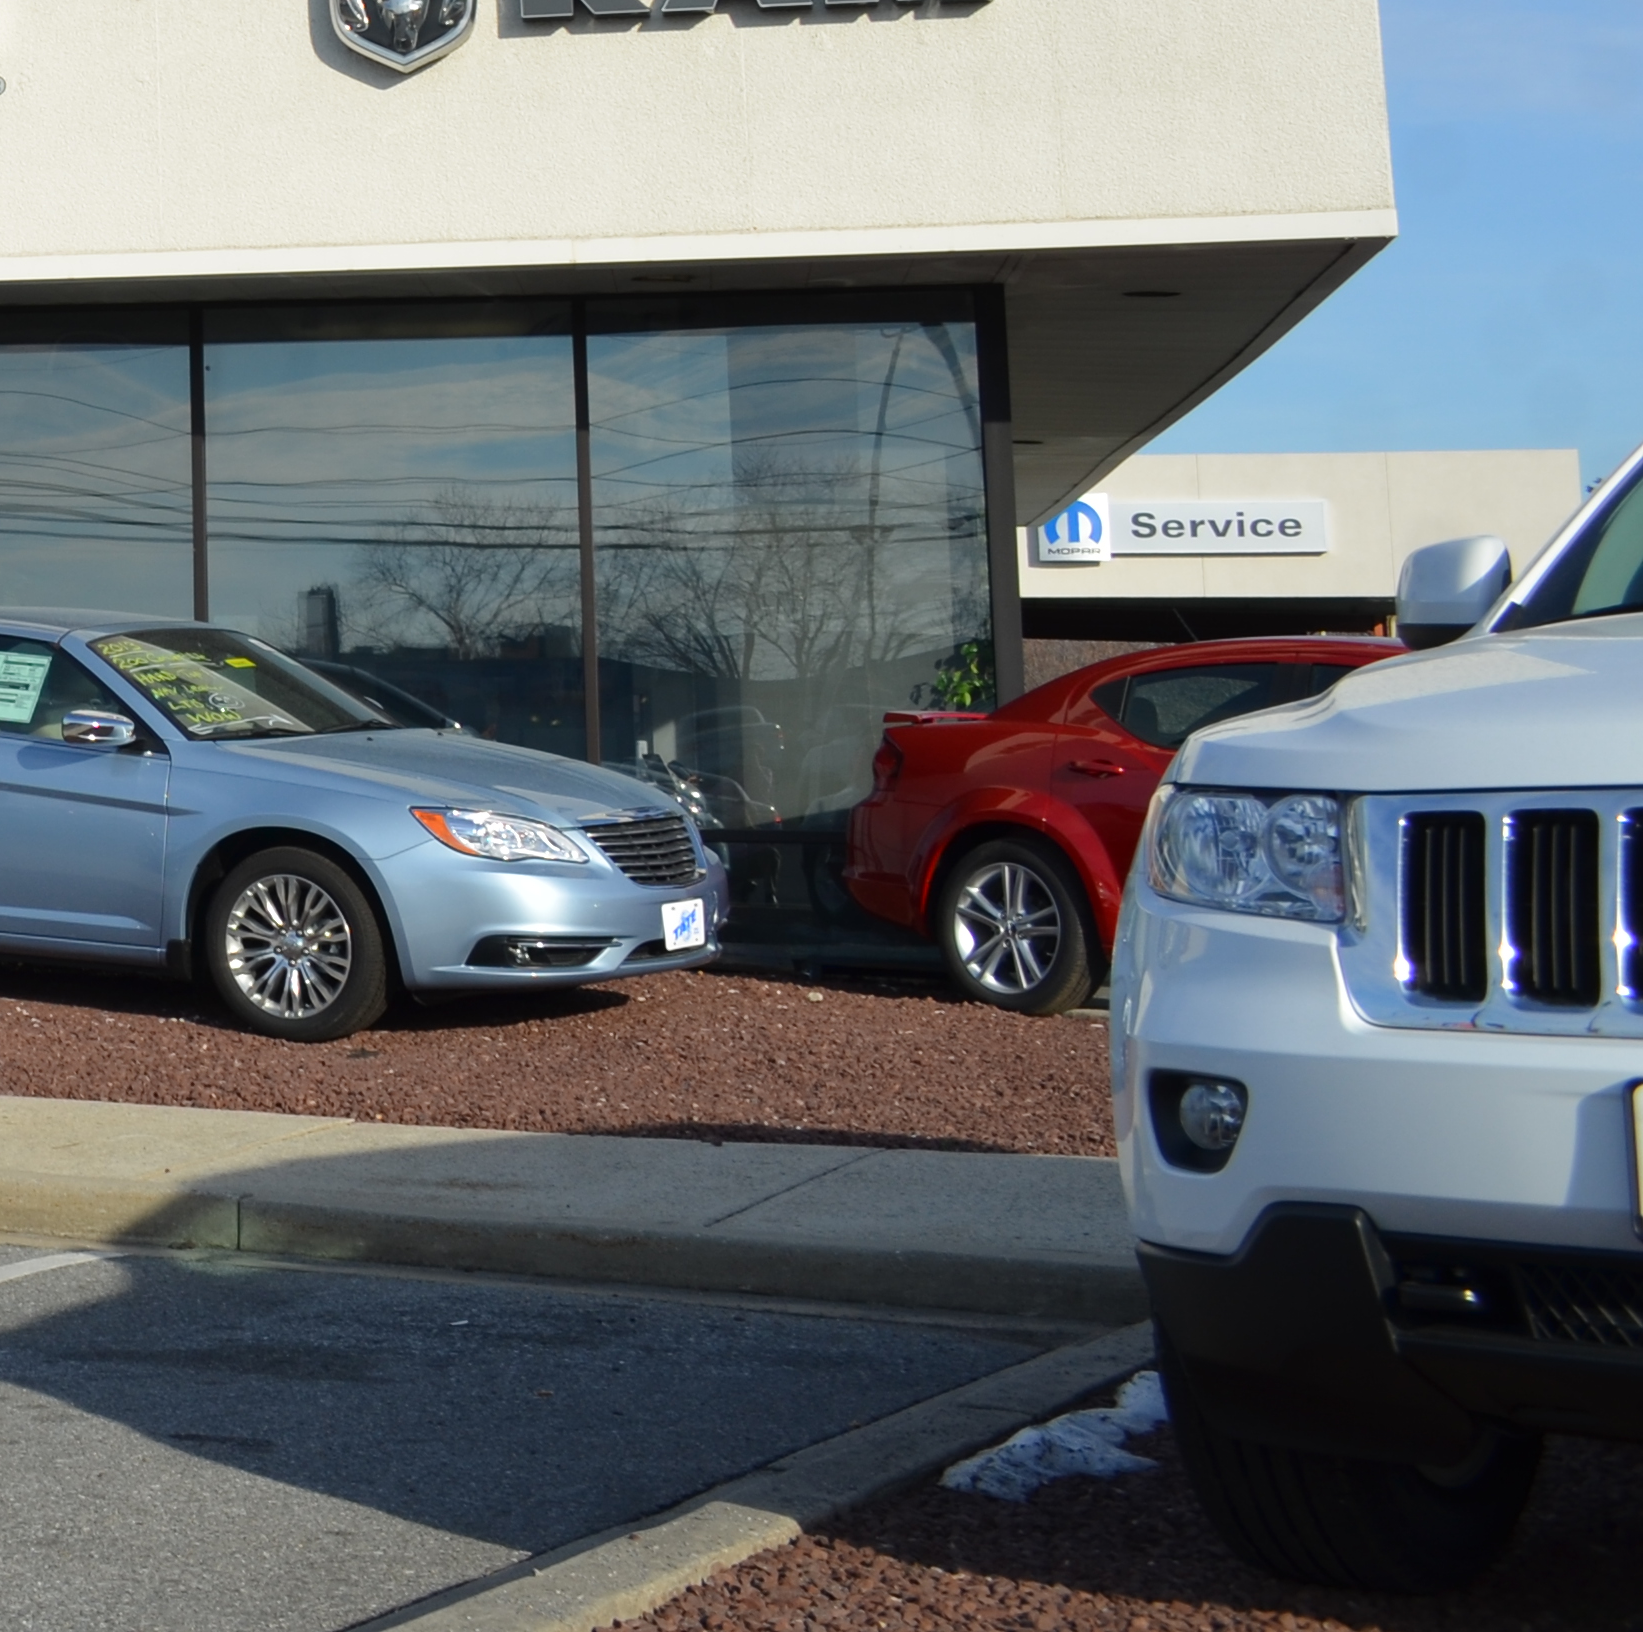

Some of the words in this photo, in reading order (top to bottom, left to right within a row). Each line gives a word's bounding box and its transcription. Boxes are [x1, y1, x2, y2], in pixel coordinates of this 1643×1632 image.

[1131, 511, 1302, 538] Service
[1048, 547, 1101, 555] MOPAR
[97, 642, 142, 655] 2013
[112, 655, 149, 670] 200
[133, 670, 178, 686] HARD
[186, 709, 242, 723] WOW
[672, 908, 697, 941] TATE
